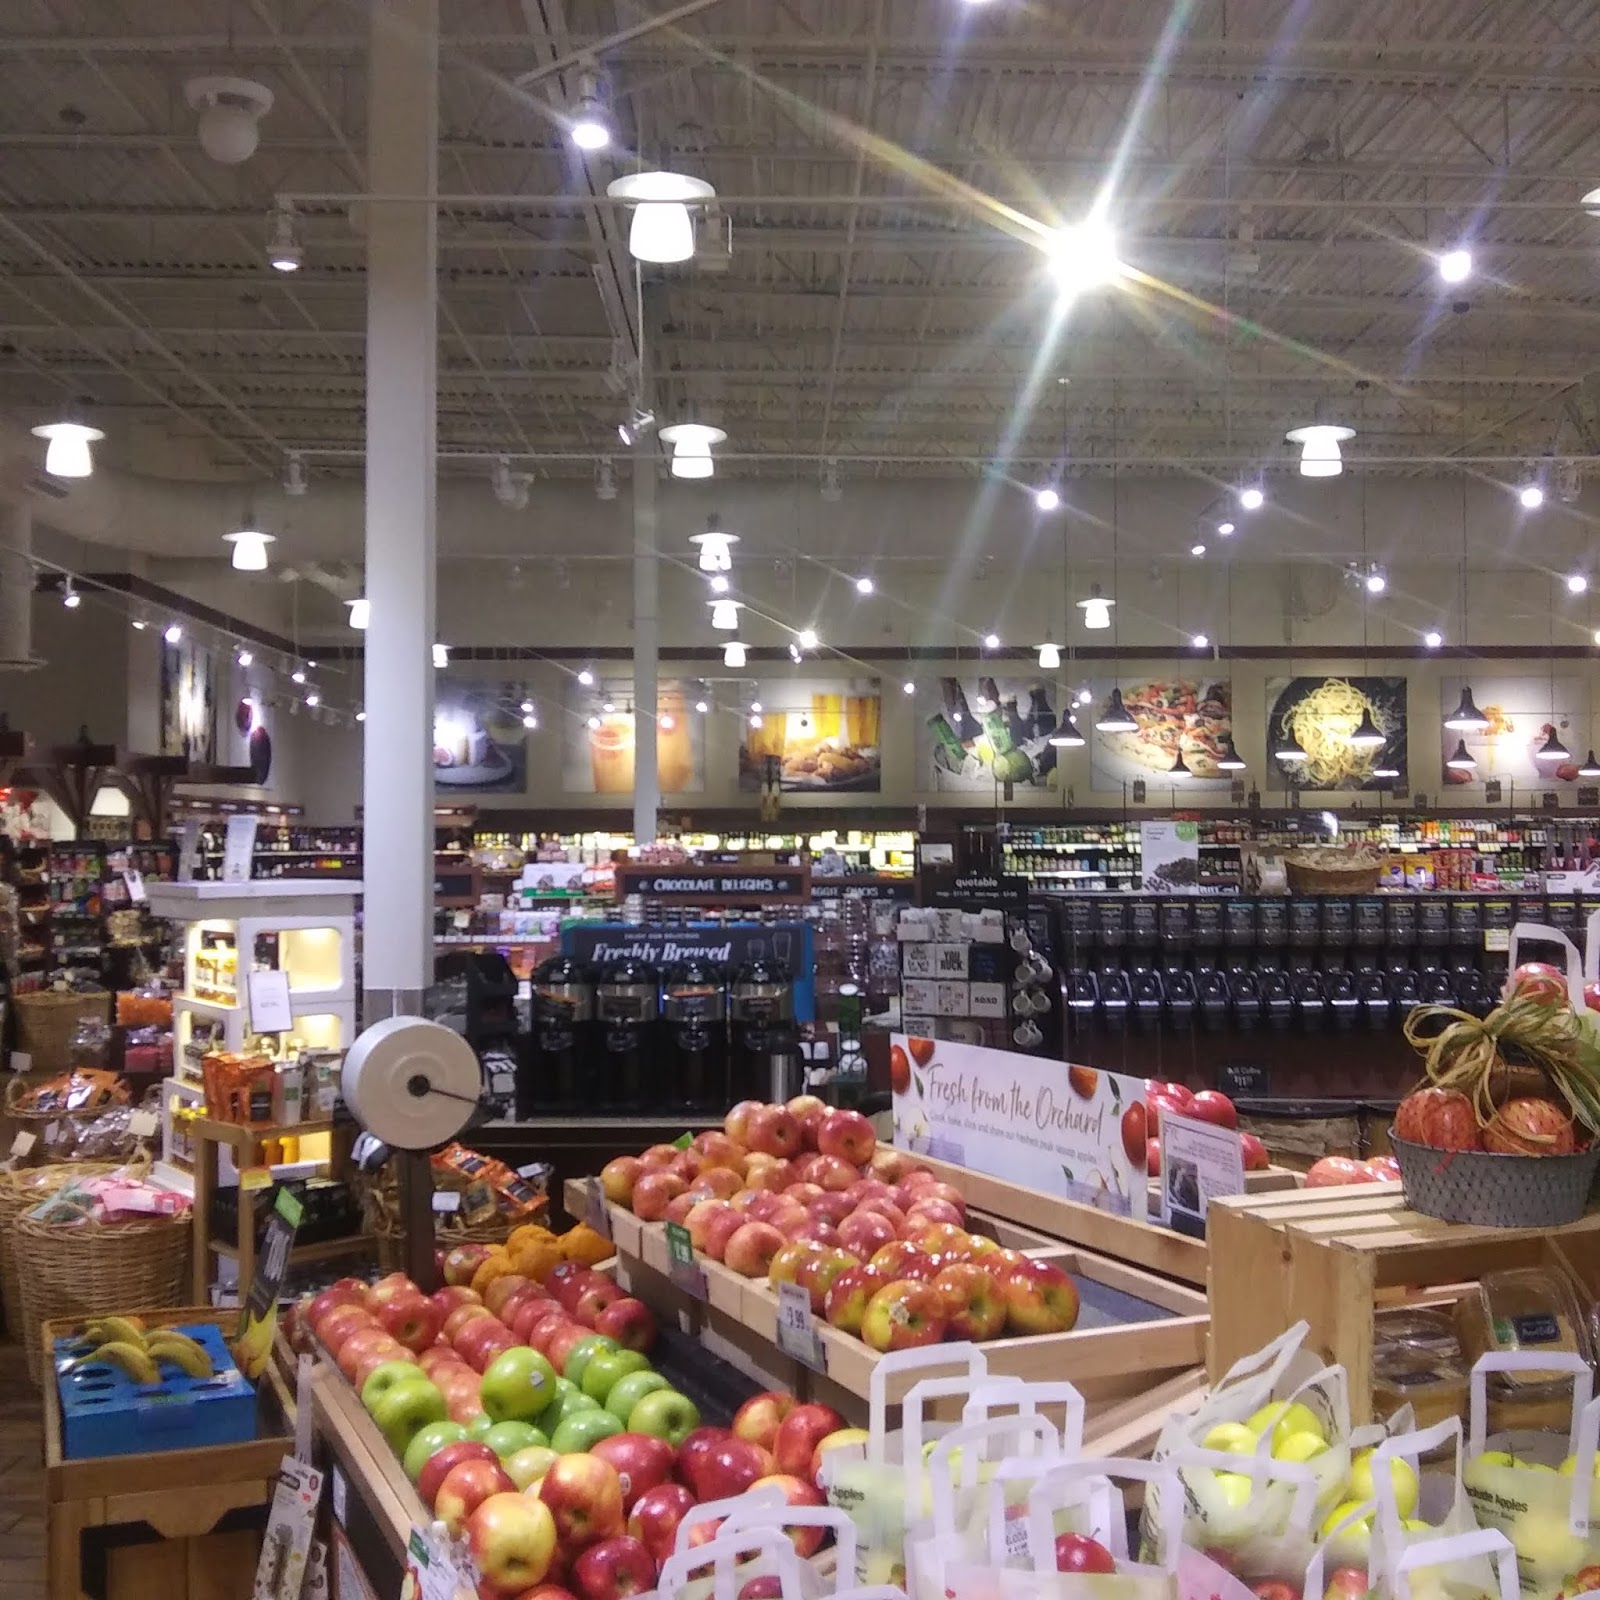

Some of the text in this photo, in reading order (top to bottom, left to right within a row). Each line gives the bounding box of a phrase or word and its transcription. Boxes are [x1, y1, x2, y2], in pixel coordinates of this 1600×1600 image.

[653, 878, 774, 892] CHOCOLATE DELIGHTS
[955, 876, 999, 890] quotable
[591, 941, 732, 963] Freshly Brewed
[943, 951, 961, 962] YOU
[940, 960, 964, 972] ROCK
[927, 1062, 1105, 1146] Fresh from the Orchard
[832, 1484, 865, 1502] Apples
[1495, 1493, 1529, 1513] Apples
